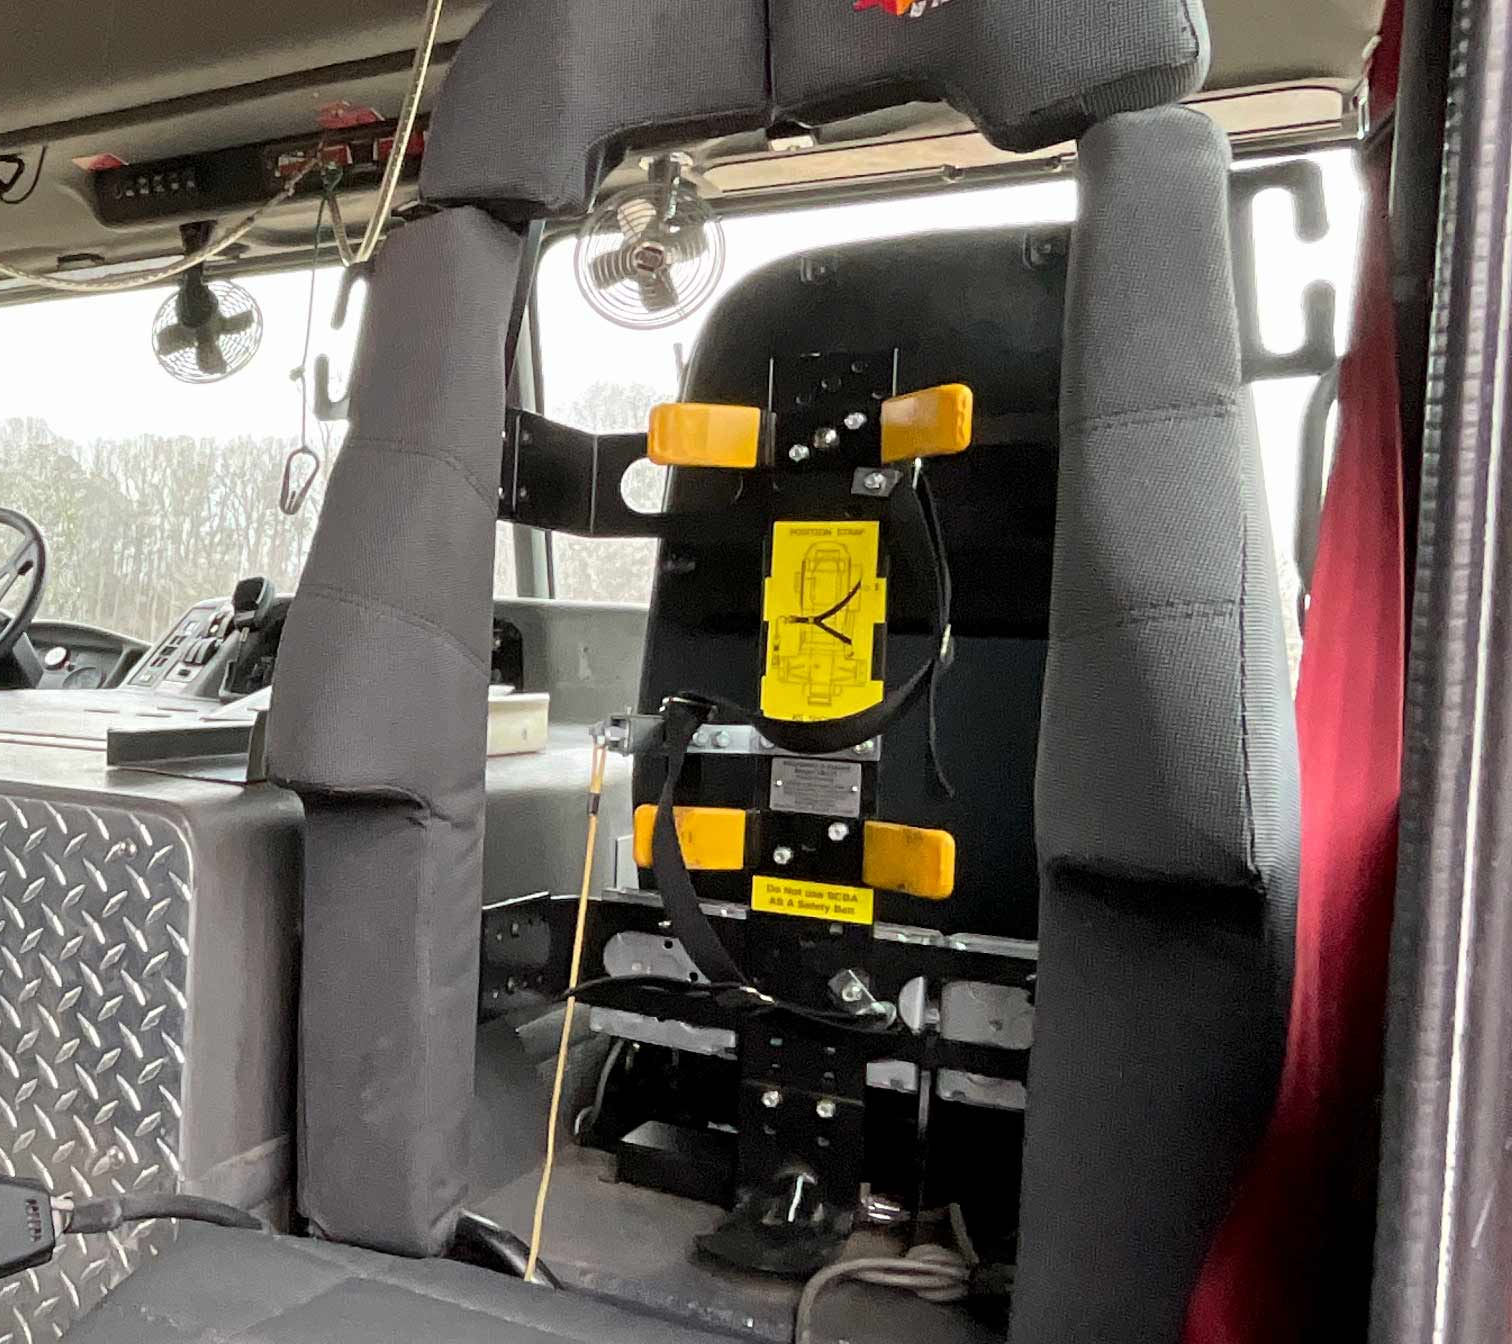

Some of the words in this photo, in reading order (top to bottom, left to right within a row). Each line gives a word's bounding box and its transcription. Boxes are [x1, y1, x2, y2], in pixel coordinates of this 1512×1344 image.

[766, 884, 782, 893] Do
[783, 886, 802, 896] Not
[797, 900, 831, 914] Safety
[834, 905, 856, 915] Belt
